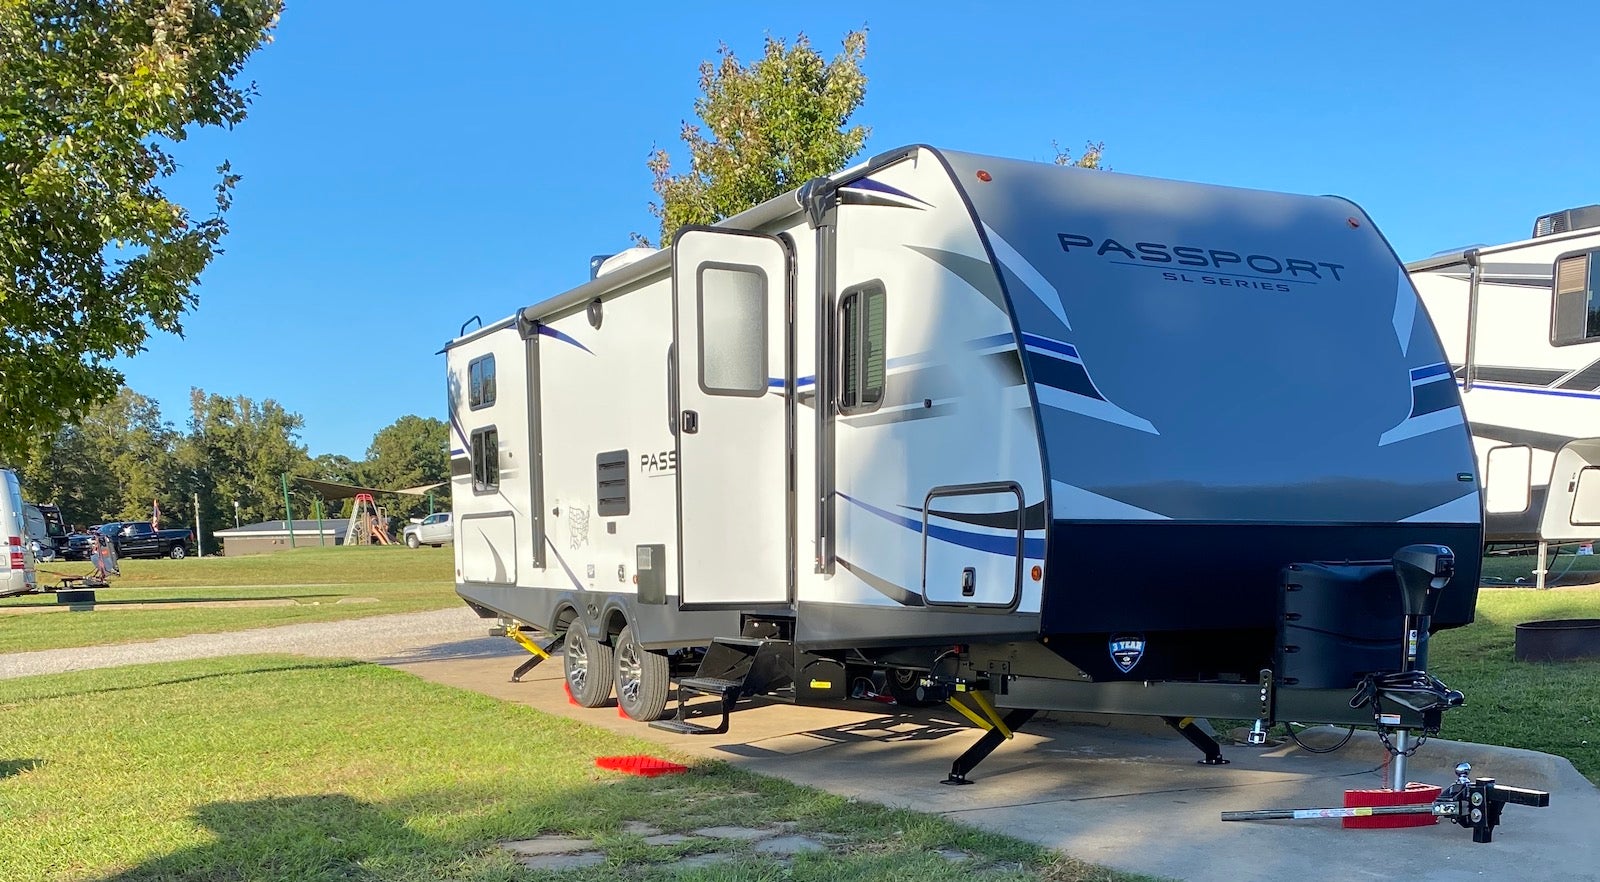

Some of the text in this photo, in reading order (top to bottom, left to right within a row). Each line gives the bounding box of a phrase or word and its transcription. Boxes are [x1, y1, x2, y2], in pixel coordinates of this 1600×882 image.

[1057, 233, 1344, 281] PASSPORT
[1162, 272, 1290, 293] SL SERIES
[1119, 641, 1142, 650] YEAR
